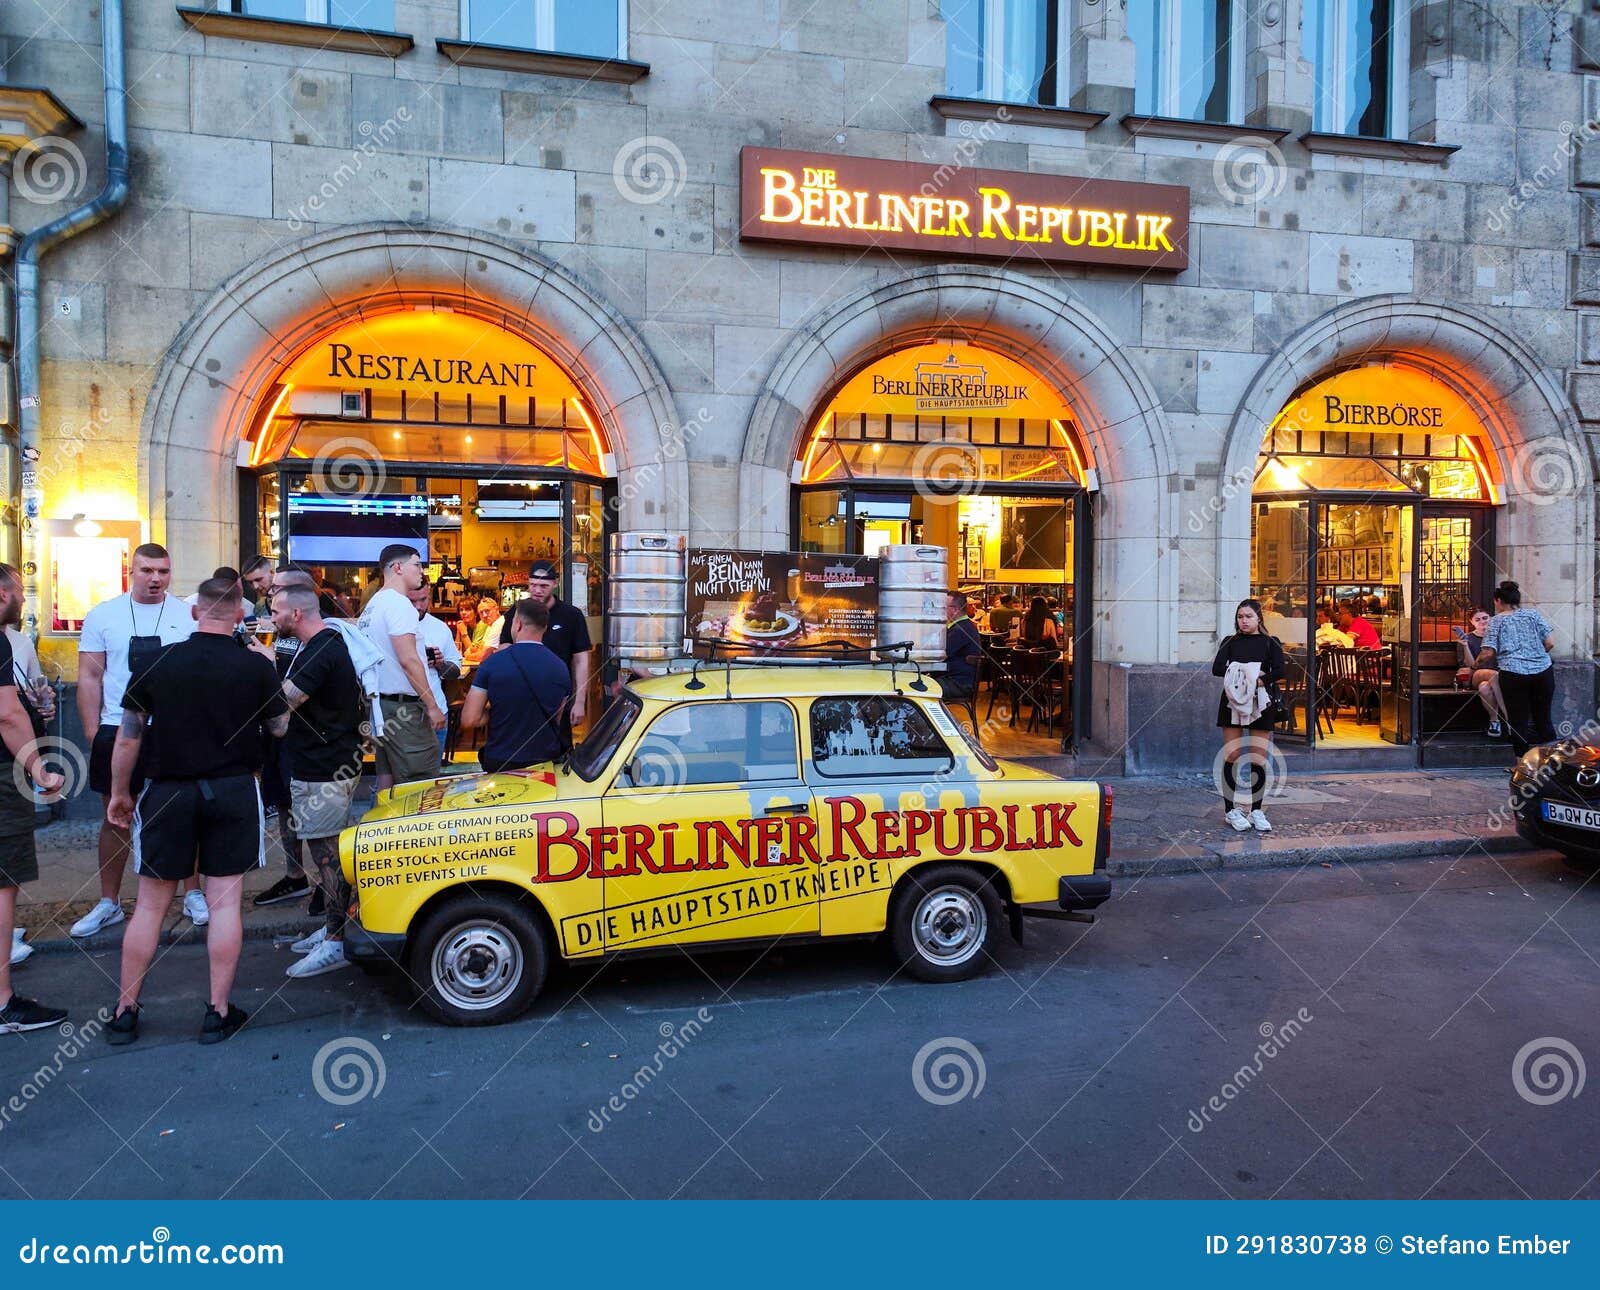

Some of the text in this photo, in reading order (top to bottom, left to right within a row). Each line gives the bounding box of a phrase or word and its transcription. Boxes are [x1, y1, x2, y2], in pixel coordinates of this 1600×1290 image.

[803, 167, 837, 190] DIE
[760, 168, 1174, 252] BERLINER REPUBLIK
[328, 343, 537, 387] RESTAURANT
[920, 398, 1004, 408] DIE HAUPTSTADTKNEIPE
[1324, 395, 1443, 427] BIERBÖRSE
[691, 554, 732, 566] AUF EINEM
[708, 560, 763, 583] BEIN KANN
[745, 568, 763, 579] MAN
[695, 580, 727, 596] NICHT
[359, 814, 529, 839] HOME MADE GERMAN FOOD
[1549, 805, 1557, 818] B
[1565, 808, 1581, 824] QW
[357, 828, 534, 854] 18 DIFFERENT DRAFT BEERS
[530, 795, 1084, 884] BERLINER REPUBLIK
[359, 846, 516, 871] BEER STOCK EXCHANGE
[360, 865, 488, 889] SPORT EVENTS LIVE
[577, 861, 881, 946] DIE HAUPTSTADTKNEIPE
